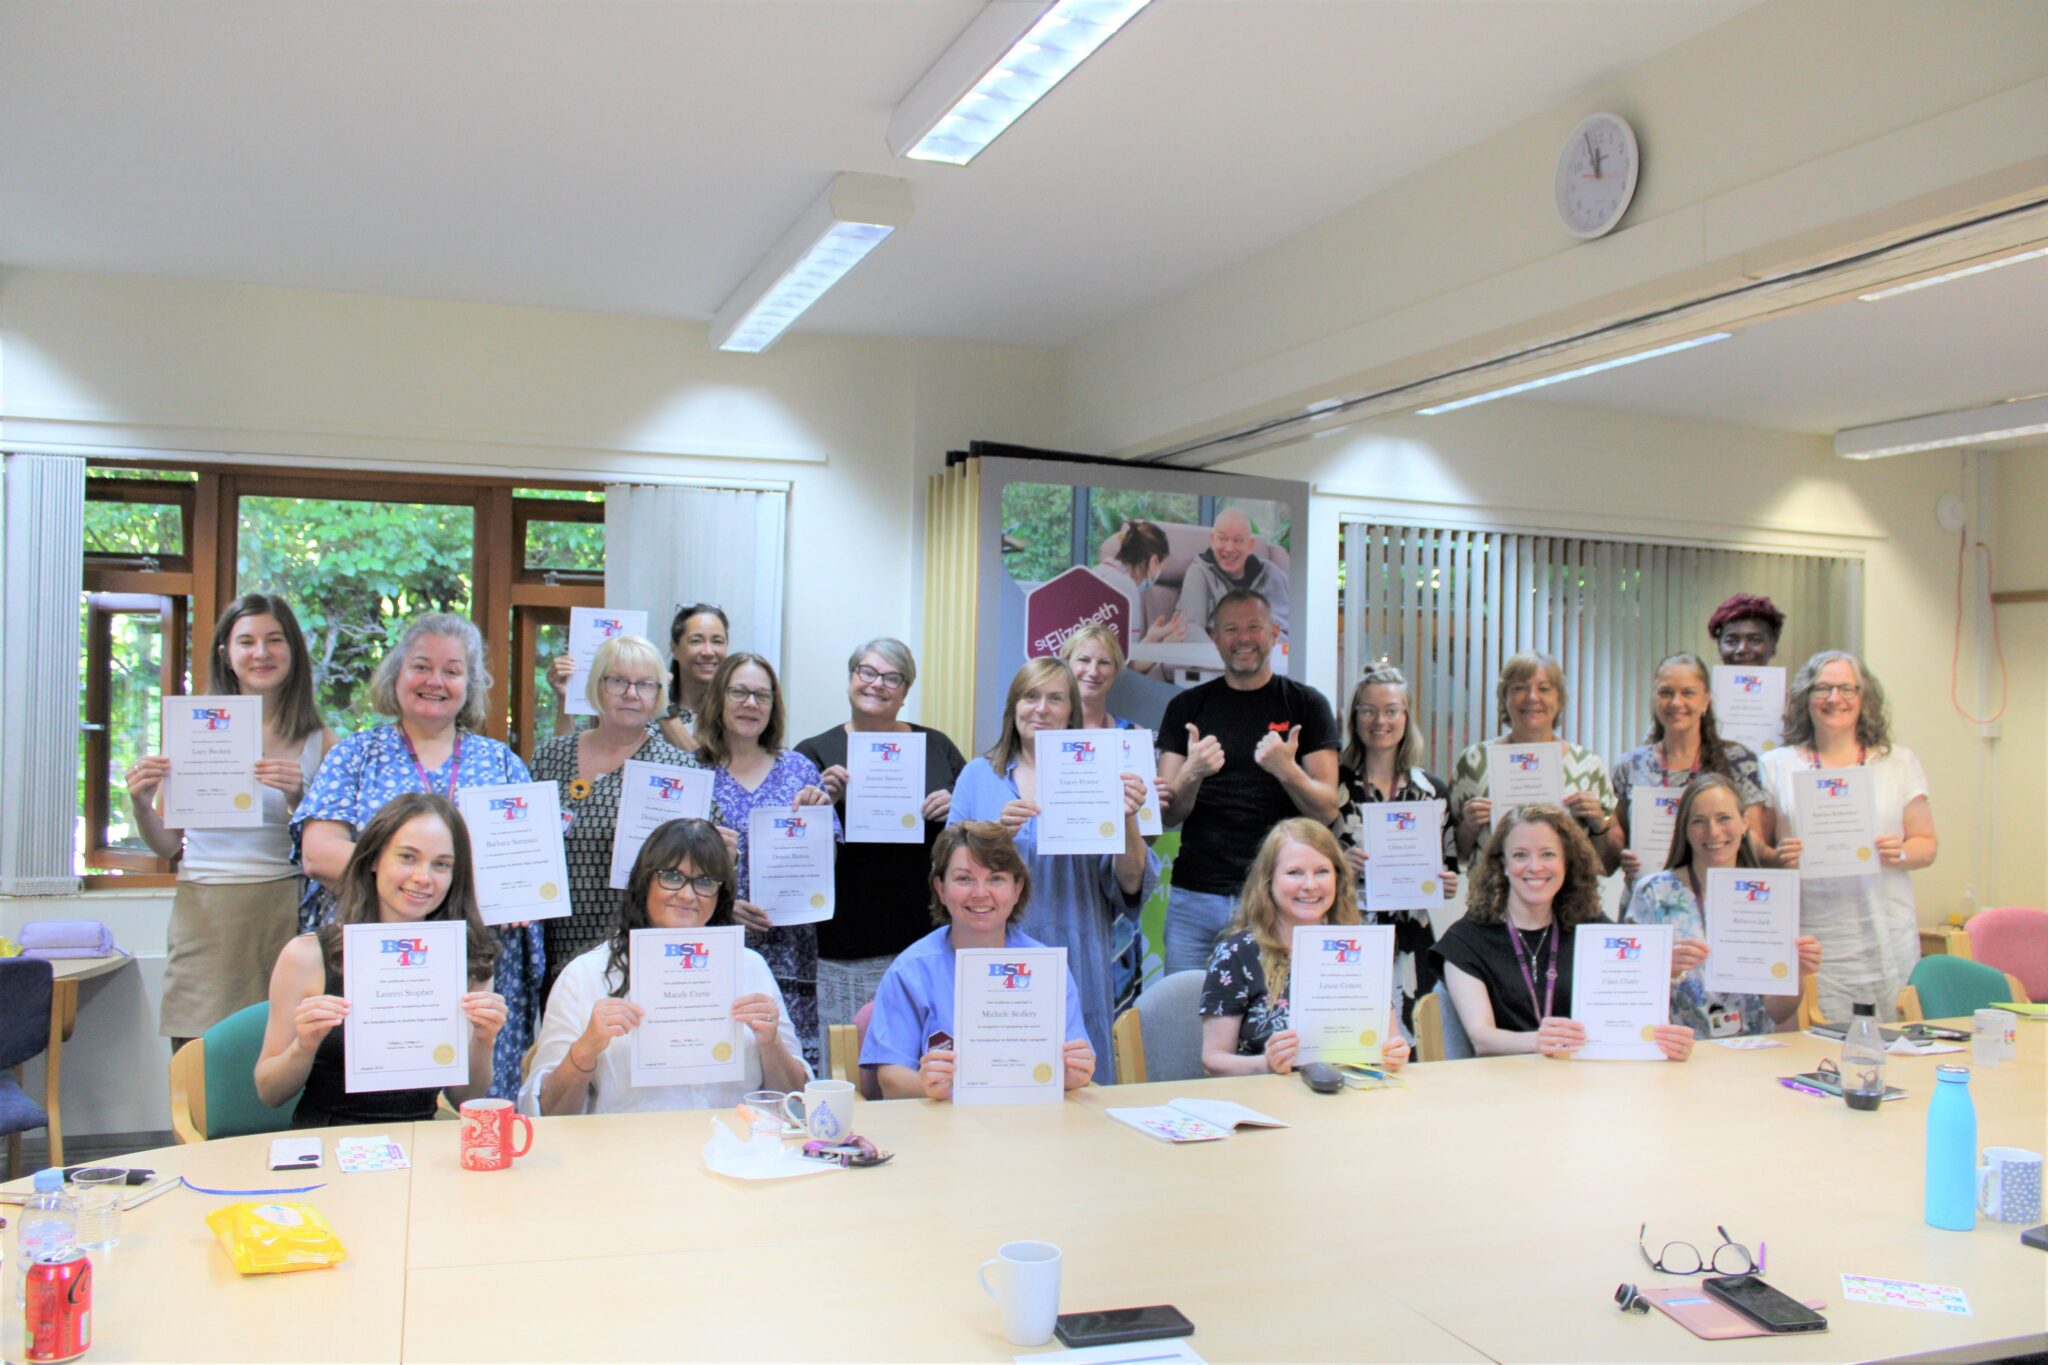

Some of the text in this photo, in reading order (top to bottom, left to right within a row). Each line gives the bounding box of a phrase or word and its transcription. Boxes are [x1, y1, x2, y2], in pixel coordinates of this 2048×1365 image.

[192, 708, 231, 720] BSL
[871, 743, 901, 753] BSL
[1061, 741, 1095, 752] BSL
[649, 775, 684, 791] BSL
[1816, 777, 1848, 788] BSL
[488, 796, 529, 811] BSL
[504, 807, 527, 820] 4U
[1386, 811, 1416, 822] BSL
[774, 818, 807, 829] BSL
[1734, 880, 1770, 892] BSL
[380, 938, 428, 954] BSL
[1322, 939, 1361, 951] BSL
[1604, 937, 1641, 949] BSL
[664, 942, 709, 957] BSL
[397, 952, 426, 966] 4U
[680, 955, 708, 969] 4U
[1335, 950, 1360, 963] 4U
[988, 963, 1032, 977] BSL
[1002, 975, 1031, 989] 4U
[376, 989, 404, 999] Lauren
